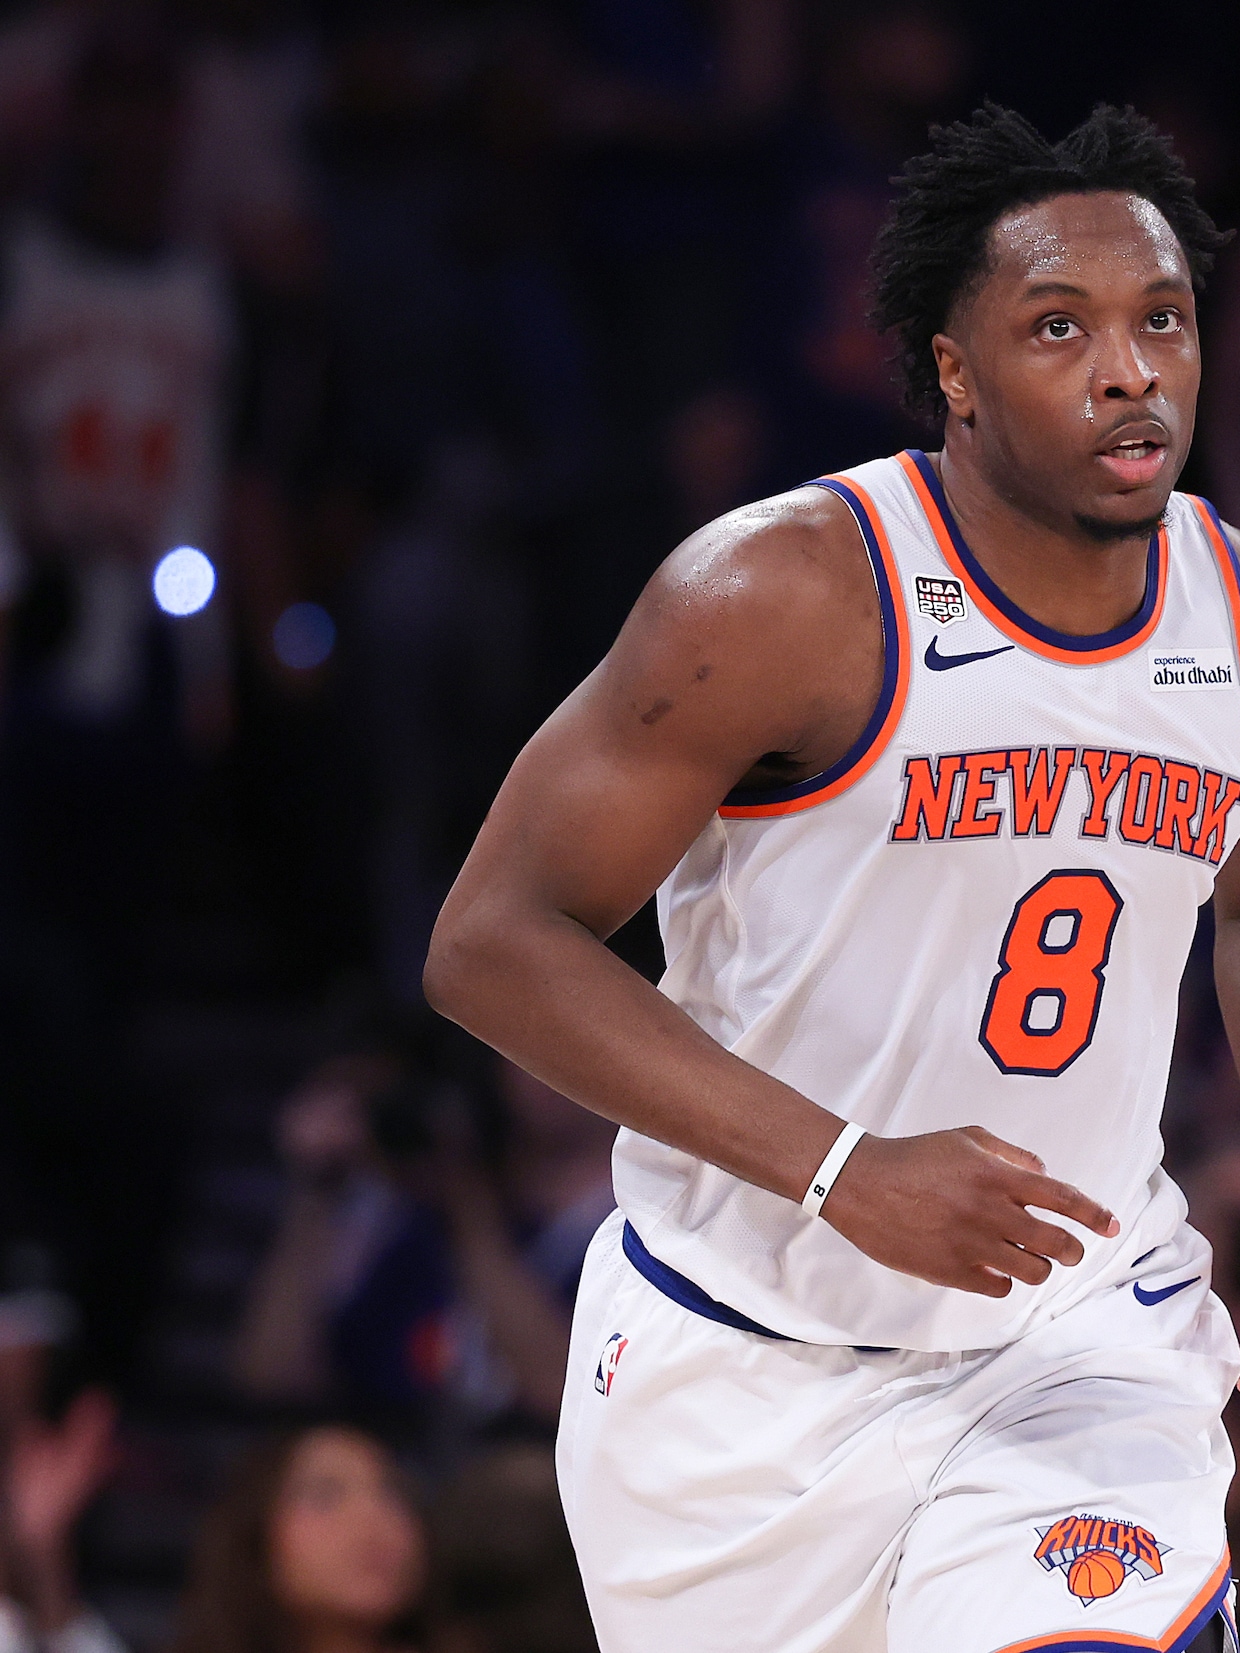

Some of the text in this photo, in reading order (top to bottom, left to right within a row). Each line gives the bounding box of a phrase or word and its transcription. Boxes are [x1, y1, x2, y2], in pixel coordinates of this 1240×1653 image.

[918, 580, 960, 596] USA
[919, 600, 965, 617] 250
[1153, 656, 1196, 666] experience
[1153, 665, 1233, 686] abu dhabi
[888, 744, 1080, 844] NEW
[978, 868, 1125, 1078] 8
[813, 1184, 826, 1198] 8
[1033, 1515, 1164, 1576] KNICKS
